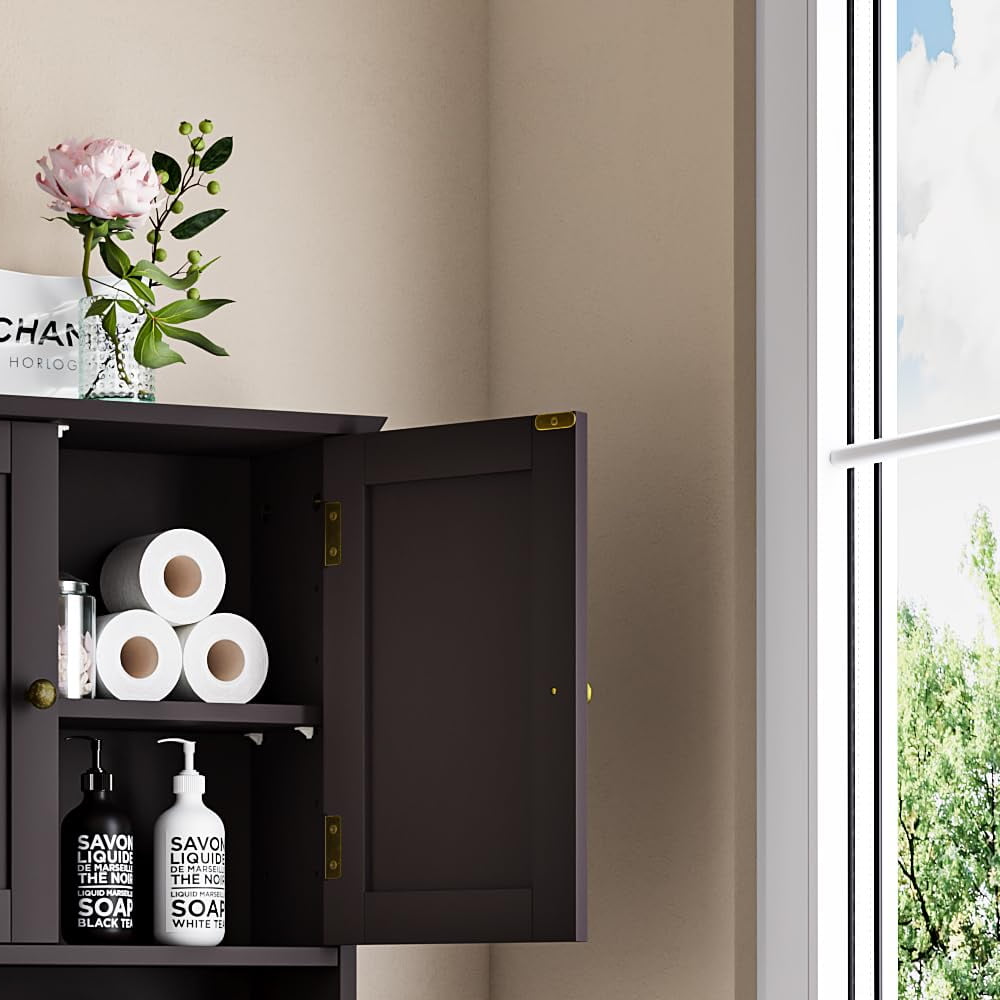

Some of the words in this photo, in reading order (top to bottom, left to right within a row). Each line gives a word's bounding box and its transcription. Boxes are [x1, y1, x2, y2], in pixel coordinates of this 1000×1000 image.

[77, 834, 133, 850] SAVON
[77, 850, 133, 864] LIQUIDE
[77, 864, 91, 872] DE
[170, 865, 184, 873] DE
[77, 871, 108, 884] THE
[170, 873, 200, 885] THE
[77, 889, 105, 897] LIQUID
[78, 897, 133, 917] SOAP
[77, 917, 119, 928] BLACK
[172, 919, 211, 928] WHITE
